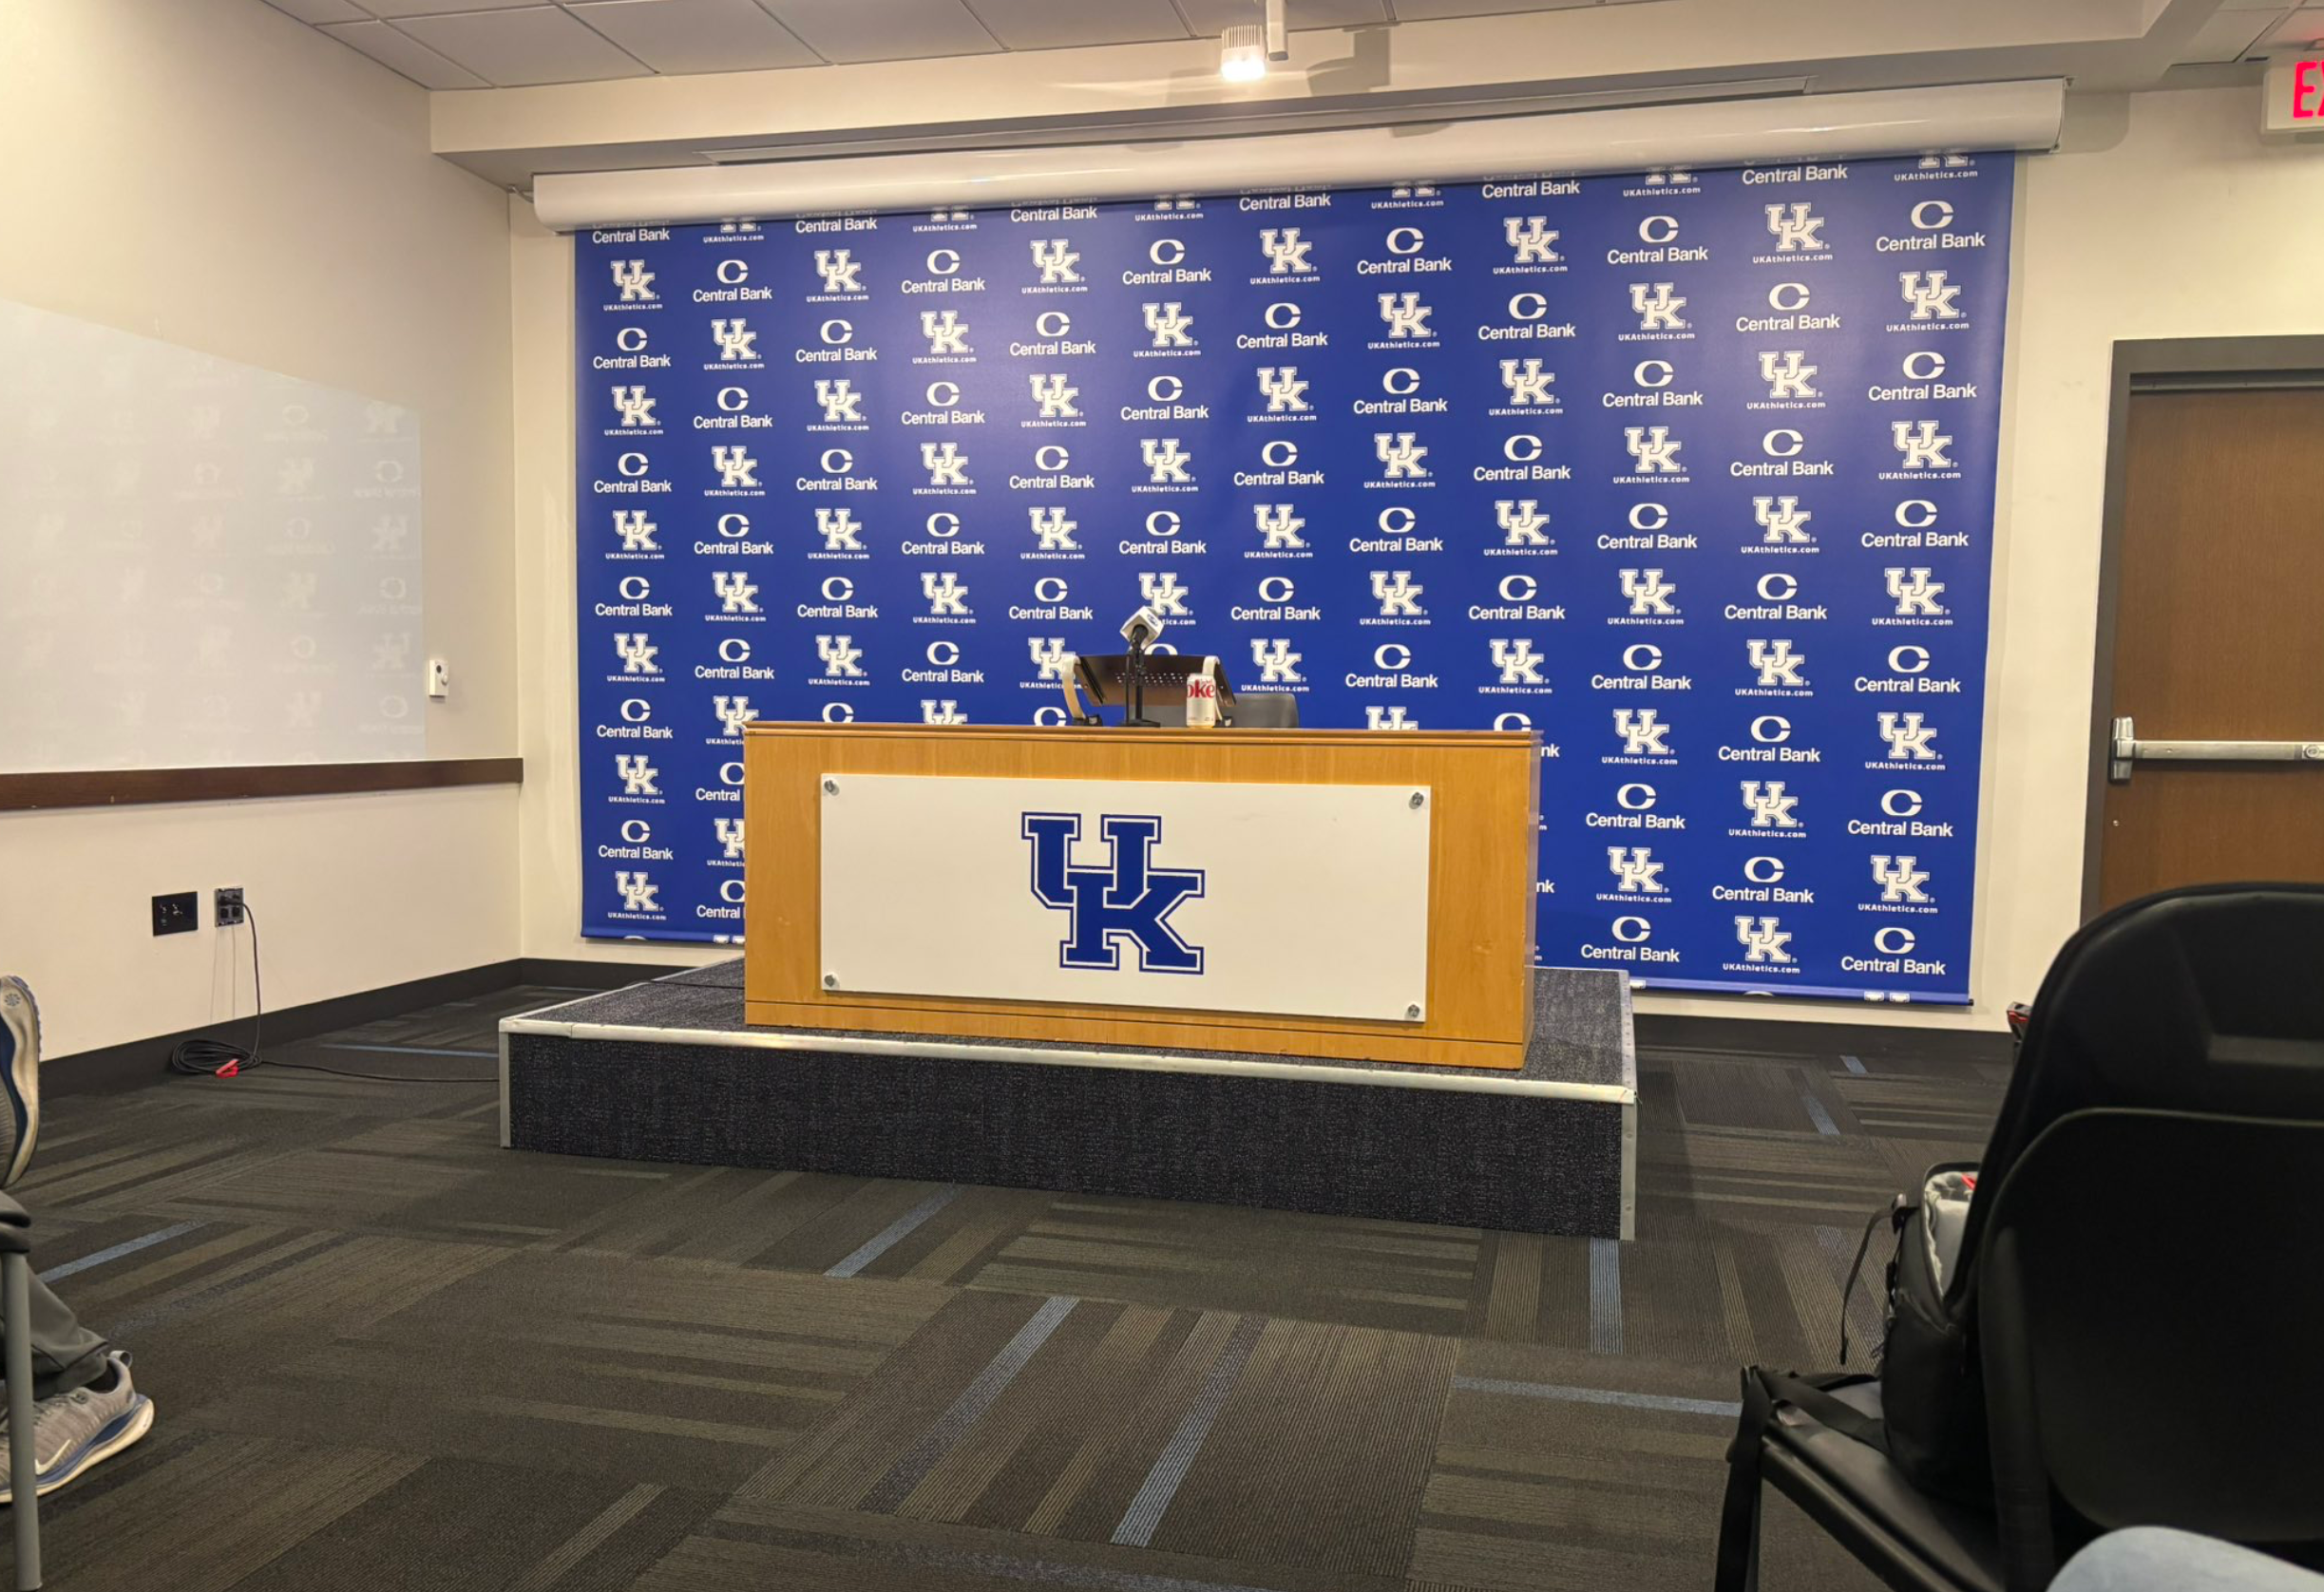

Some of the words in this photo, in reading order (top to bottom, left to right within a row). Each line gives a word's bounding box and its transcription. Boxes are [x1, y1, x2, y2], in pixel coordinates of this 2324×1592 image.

[1743, 168, 1800, 185] Central
[1805, 165, 1847, 180] Bank
[1895, 171, 1978, 180] UKAthletics.com
[1482, 183, 1536, 199] Central
[1541, 180, 1580, 195] Bank
[1623, 187, 1701, 197] UKAthletics.com
[1239, 196, 1290, 211] Central
[1294, 194, 1331, 208] Bank
[1371, 200, 1444, 209] UKAthletics.com
[1011, 208, 1059, 222] Central
[1062, 207, 1097, 219] Bank
[1134, 213, 1204, 221] UKAthletics.com
[796, 219, 841, 234] Central
[845, 218, 877, 231] Bank
[913, 224, 977, 233] UKAthletics.com
[1764, 202, 1824, 252] UK
[593, 230, 636, 243] Central
[638, 228, 670, 241] Bank
[703, 235, 764, 243] UKAthletics.com
[1876, 234, 1937, 252] Central
[1941, 232, 1986, 248] Bank
[1259, 227, 1318, 275] UK
[1607, 247, 1664, 265] Central
[1667, 246, 1708, 262] Bank
[1753, 255, 1833, 264] UKAthletics.com
[1357, 257, 1411, 275] Central
[1413, 256, 1452, 273] Bank
[1493, 266, 1568, 275] UKAthletics.com
[611, 259, 660, 302] UK
[1899, 270, 1960, 320] UK
[1629, 282, 1686, 331] UK
[1378, 292, 1438, 339] UK
[1736, 315, 1795, 332] Central
[1798, 313, 1840, 330] Bank
[921, 310, 974, 354] UK
[1142, 302, 1198, 348] UK
[1477, 324, 1533, 340] Central
[1536, 323, 1576, 338] Bank
[1886, 323, 1970, 332] UKAthletics.com
[1236, 332, 1288, 350] Central
[1291, 332, 1328, 347] Bank
[1618, 332, 1695, 341] UKAthletics.com
[593, 355, 638, 369] Central
[639, 353, 672, 368] Bank
[795, 348, 842, 363] Central
[844, 347, 877, 361] Bank
[1759, 350, 1818, 399] UK
[1257, 366, 1314, 412] UK
[1868, 384, 1930, 401] Central
[1933, 383, 1977, 399] Bank
[1353, 398, 1407, 415] Central
[1409, 397, 1448, 413] Bank
[1602, 391, 1659, 407] Central
[1663, 390, 1703, 406] Bank
[1746, 401, 1826, 409] UKAthletics.com
[1488, 407, 1563, 416] UKAthletics.com
[1020, 420, 1086, 428] UKAthletics.com
[1624, 426, 1682, 473] UK
[1892, 420, 1953, 469] UK
[1140, 438, 1196, 483] UK
[1374, 431, 1433, 479] UK
[1473, 465, 1529, 482] Central
[1532, 464, 1572, 480] Bank
[1730, 461, 1788, 477] Central
[1792, 460, 1834, 476] Bank
[1878, 471, 1961, 480] UKAthletics.com
[1233, 470, 1286, 486] Central
[1287, 470, 1324, 485] Bank
[1612, 476, 1690, 484] UKAthletics.com
[1028, 506, 1082, 550] UK
[1253, 503, 1310, 549] UK
[1495, 499, 1555, 546] UK
[1753, 496, 1817, 543] UK
[814, 508, 867, 551] UK
[694, 540, 739, 555] Central
[741, 540, 774, 555] Bank
[901, 540, 948, 555] Central
[951, 540, 985, 555] Bank
[1348, 537, 1402, 553] Central
[1405, 537, 1443, 552] Bank
[1597, 534, 1654, 550] Central
[1657, 534, 1698, 549] Bank
[1861, 532, 1922, 548] Central
[1925, 531, 1969, 547] Bank
[1483, 548, 1558, 557] UKAthletics.com
[1741, 545, 1819, 554] UKAthletics.com
[1369, 570, 1428, 616] UK
[1618, 568, 1681, 615] UK
[1884, 567, 1951, 616] UK
[1230, 606, 1282, 621] Central
[1284, 606, 1321, 621] Bank
[1468, 605, 1523, 620] Central
[1526, 605, 1566, 620] Bank
[1724, 604, 1782, 619] Central
[1785, 604, 1827, 620] Bank
[1872, 617, 1953, 626] UKAthletics.com
[614, 633, 663, 674] UK
[815, 635, 867, 677] UK
[1250, 638, 1307, 683] UK
[1489, 638, 1550, 685] UK
[1746, 639, 1810, 687] UK
[695, 665, 740, 679] Central
[742, 666, 775, 680] Bank
[901, 668, 948, 683] Central
[950, 669, 984, 683] Bank
[1344, 673, 1398, 689] Central
[1400, 673, 1438, 689] Bank
[1477, 686, 1553, 694] UKAthletics.com
[1591, 673, 1648, 690] Central
[1650, 674, 1692, 690] Bank
[1854, 676, 1914, 692] Central
[1917, 677, 1961, 693] Bank
[1734, 688, 1814, 697] UKAthletics.com
[1612, 709, 1675, 755] UK
[1876, 711, 1943, 760] UK
[1601, 756, 1678, 766] UKAthletics.com
[1718, 746, 1776, 762] Central
[1780, 747, 1821, 763] Bank
[1864, 761, 1946, 770] UKAthletics.com
[1740, 780, 1804, 828] UK
[1585, 812, 1642, 828] Central
[1645, 813, 1686, 829] Bank
[1847, 819, 1907, 836] Central
[1910, 821, 1953, 838] Bank
[1728, 828, 1807, 838] UKAthletics.com
[598, 844, 640, 859] Central
[642, 846, 674, 861] Bank
[1607, 845, 1669, 894] UK
[1870, 854, 1935, 903] UK
[615, 870, 664, 912] UK
[1021, 811, 1206, 976] UK
[1595, 893, 1672, 903] UKAthletics.com
[1711, 884, 1770, 902] Central
[1772, 887, 1815, 903] Bank
[607, 912, 666, 920] UKAthletics.com
[1857, 903, 1938, 914] UKAthletics.com
[1734, 915, 1798, 963] UK
[1580, 943, 1637, 960] Central
[1640, 946, 1680, 963] Bank
[1723, 963, 1800, 974] UKAthletics.com
[1840, 956, 1900, 973] Central
[1903, 958, 1946, 975] Bank
